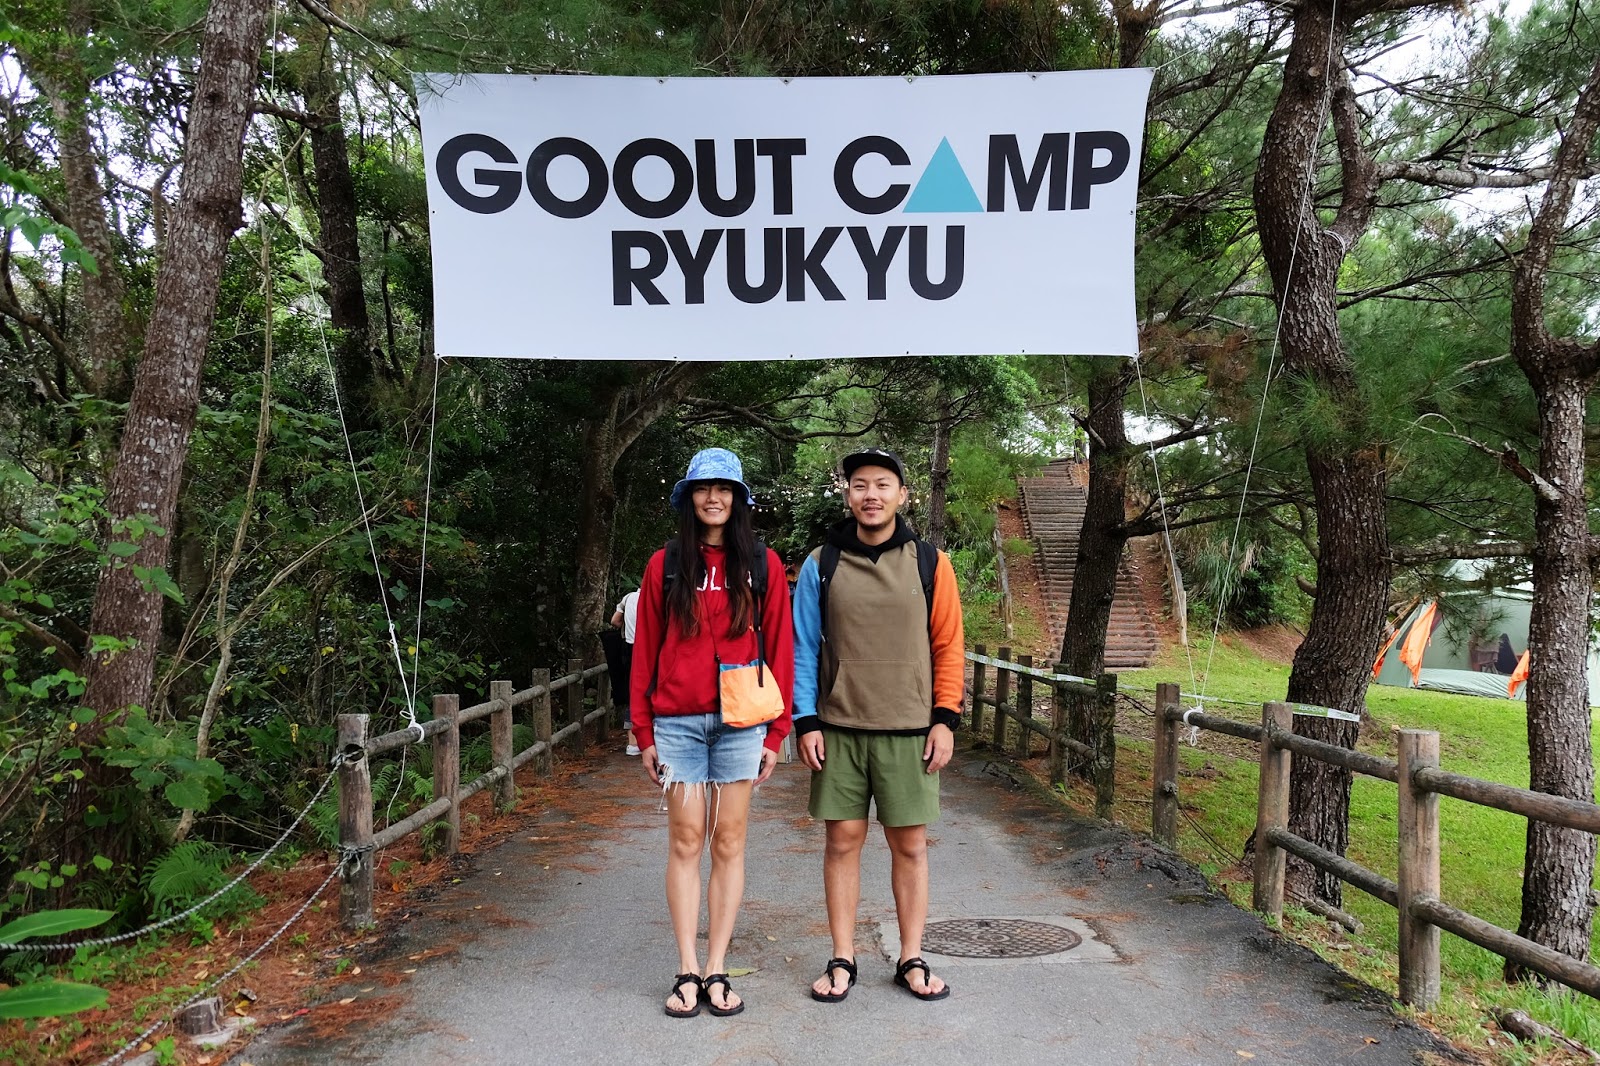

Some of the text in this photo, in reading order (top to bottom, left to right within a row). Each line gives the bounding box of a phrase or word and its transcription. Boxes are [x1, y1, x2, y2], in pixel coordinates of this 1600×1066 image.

[436, 131, 1130, 218] GOOUT CAMP
[612, 226, 965, 305] RYUKYU
